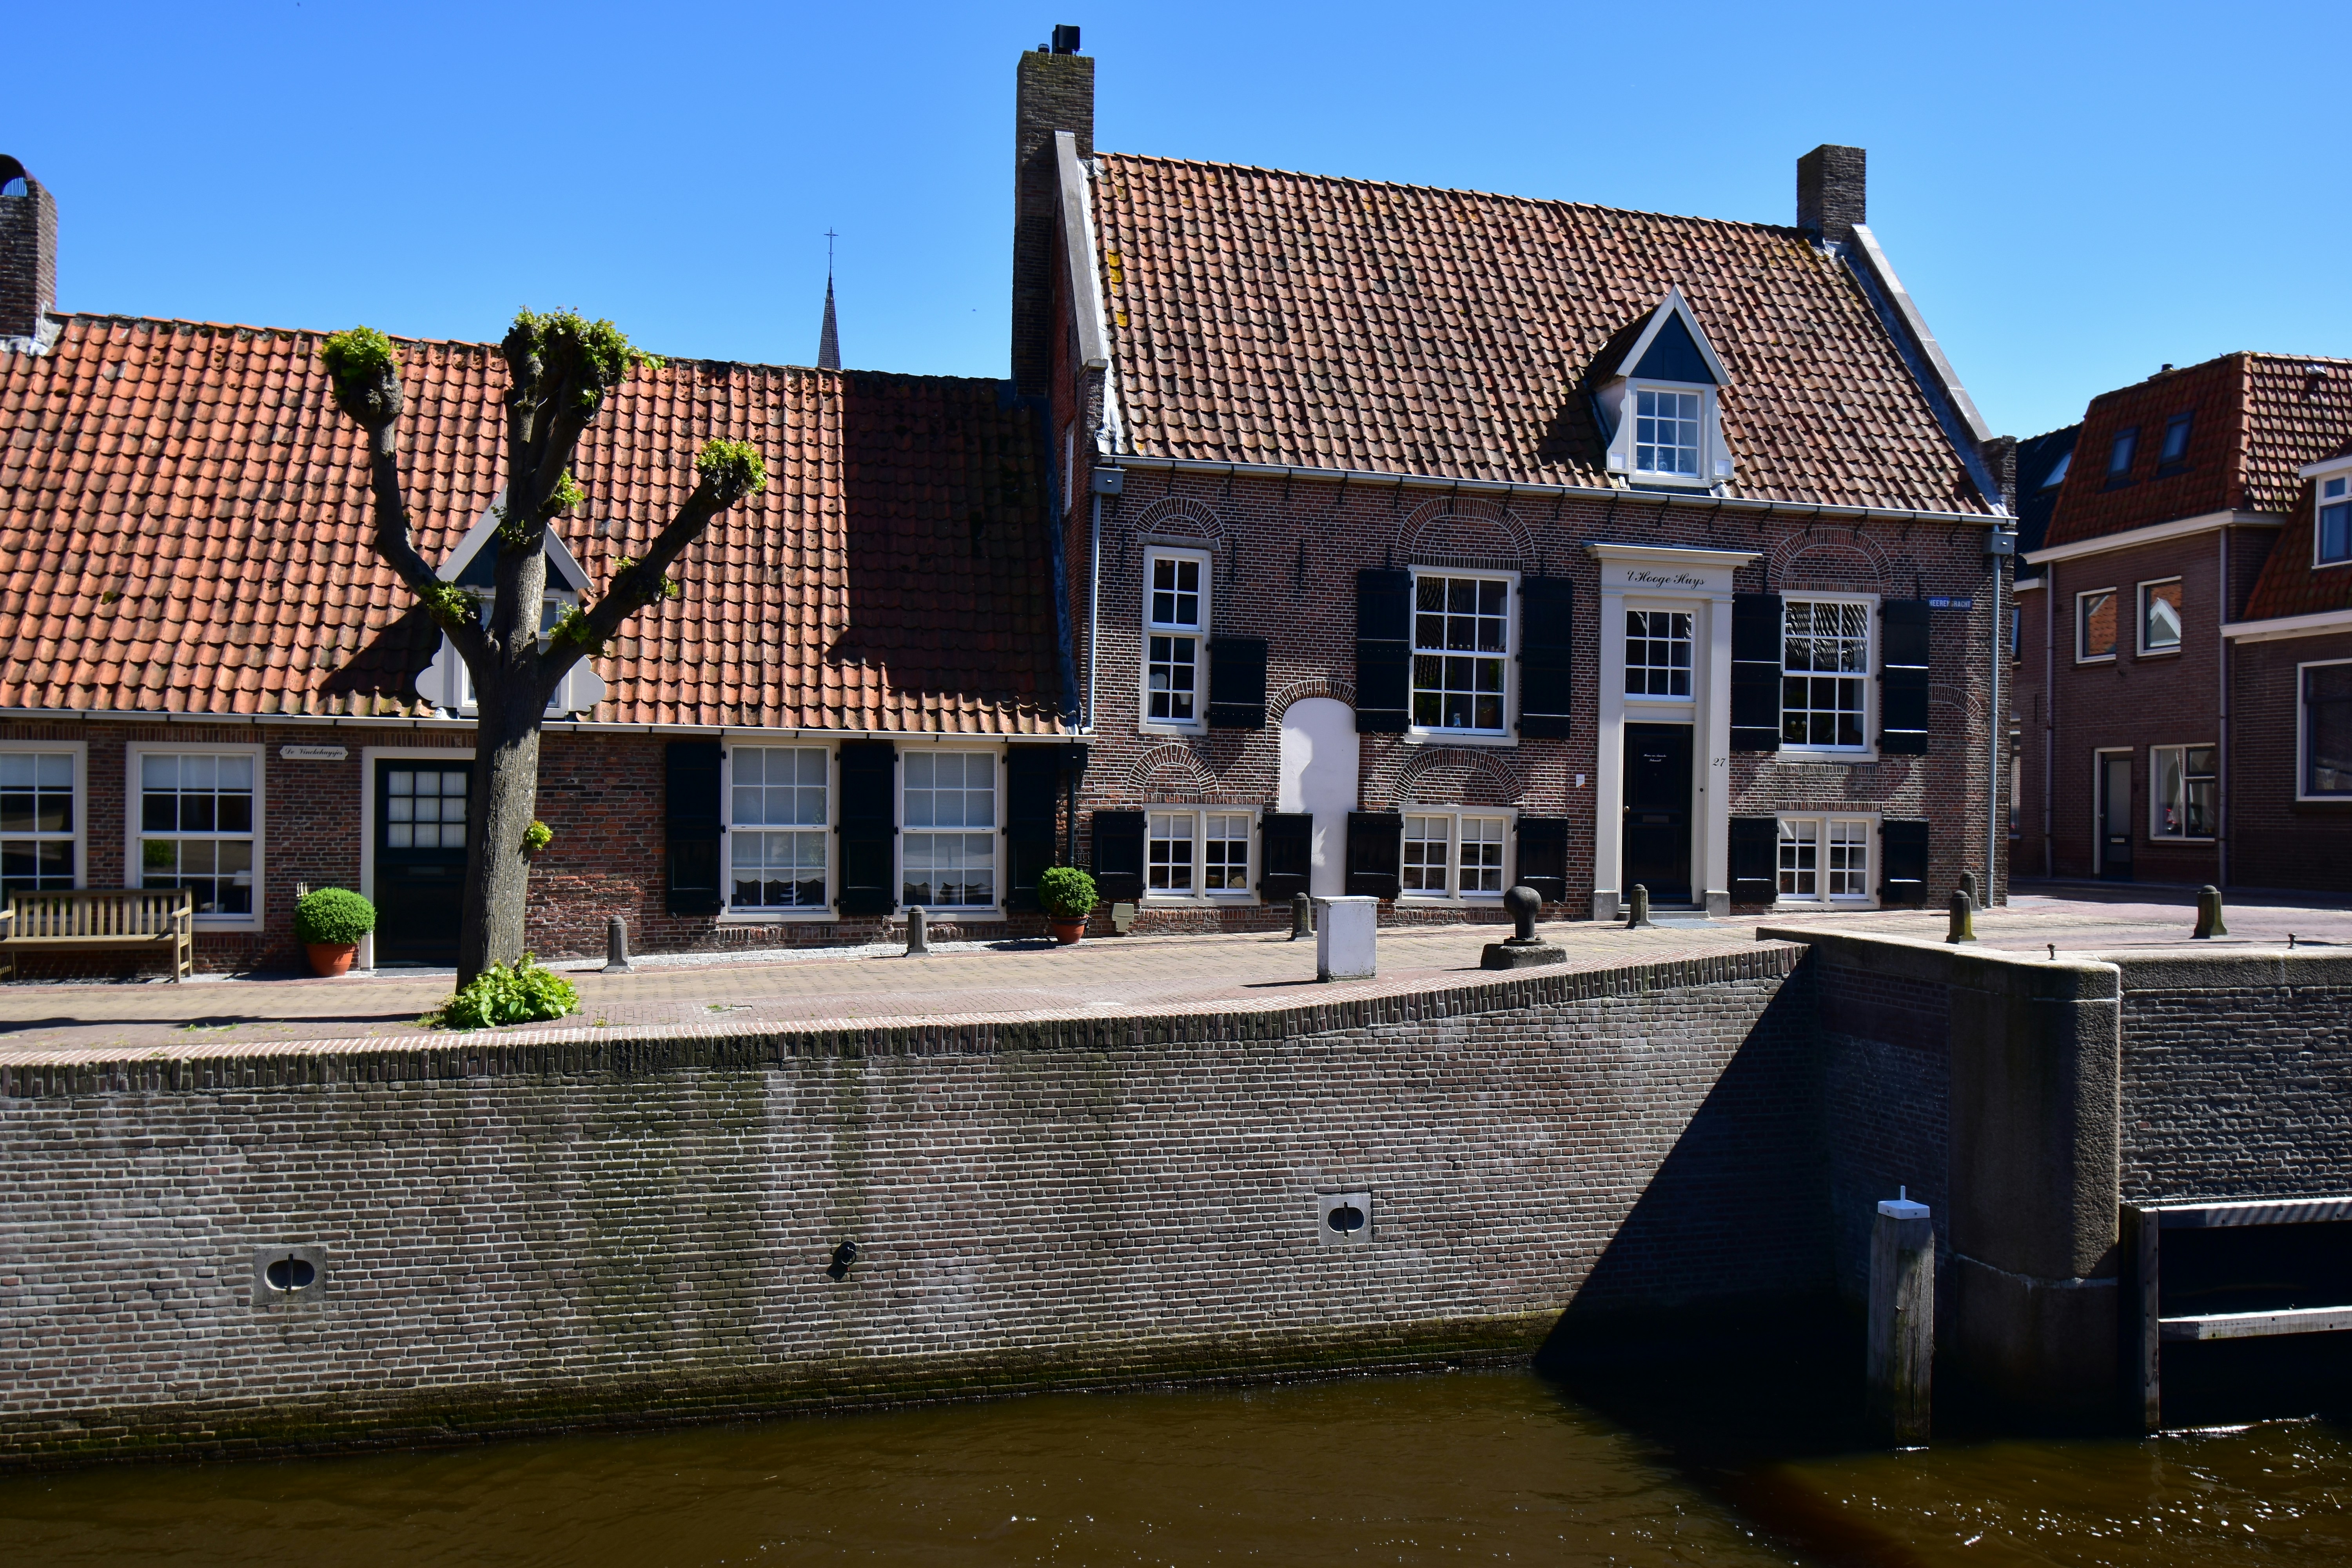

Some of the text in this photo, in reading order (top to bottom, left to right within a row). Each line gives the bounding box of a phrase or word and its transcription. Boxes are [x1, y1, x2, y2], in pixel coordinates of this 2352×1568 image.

[1635, 571, 1672, 588] Hooge
[1673, 573, 1706, 589] Huys
[1712, 758, 1726, 767] 27
